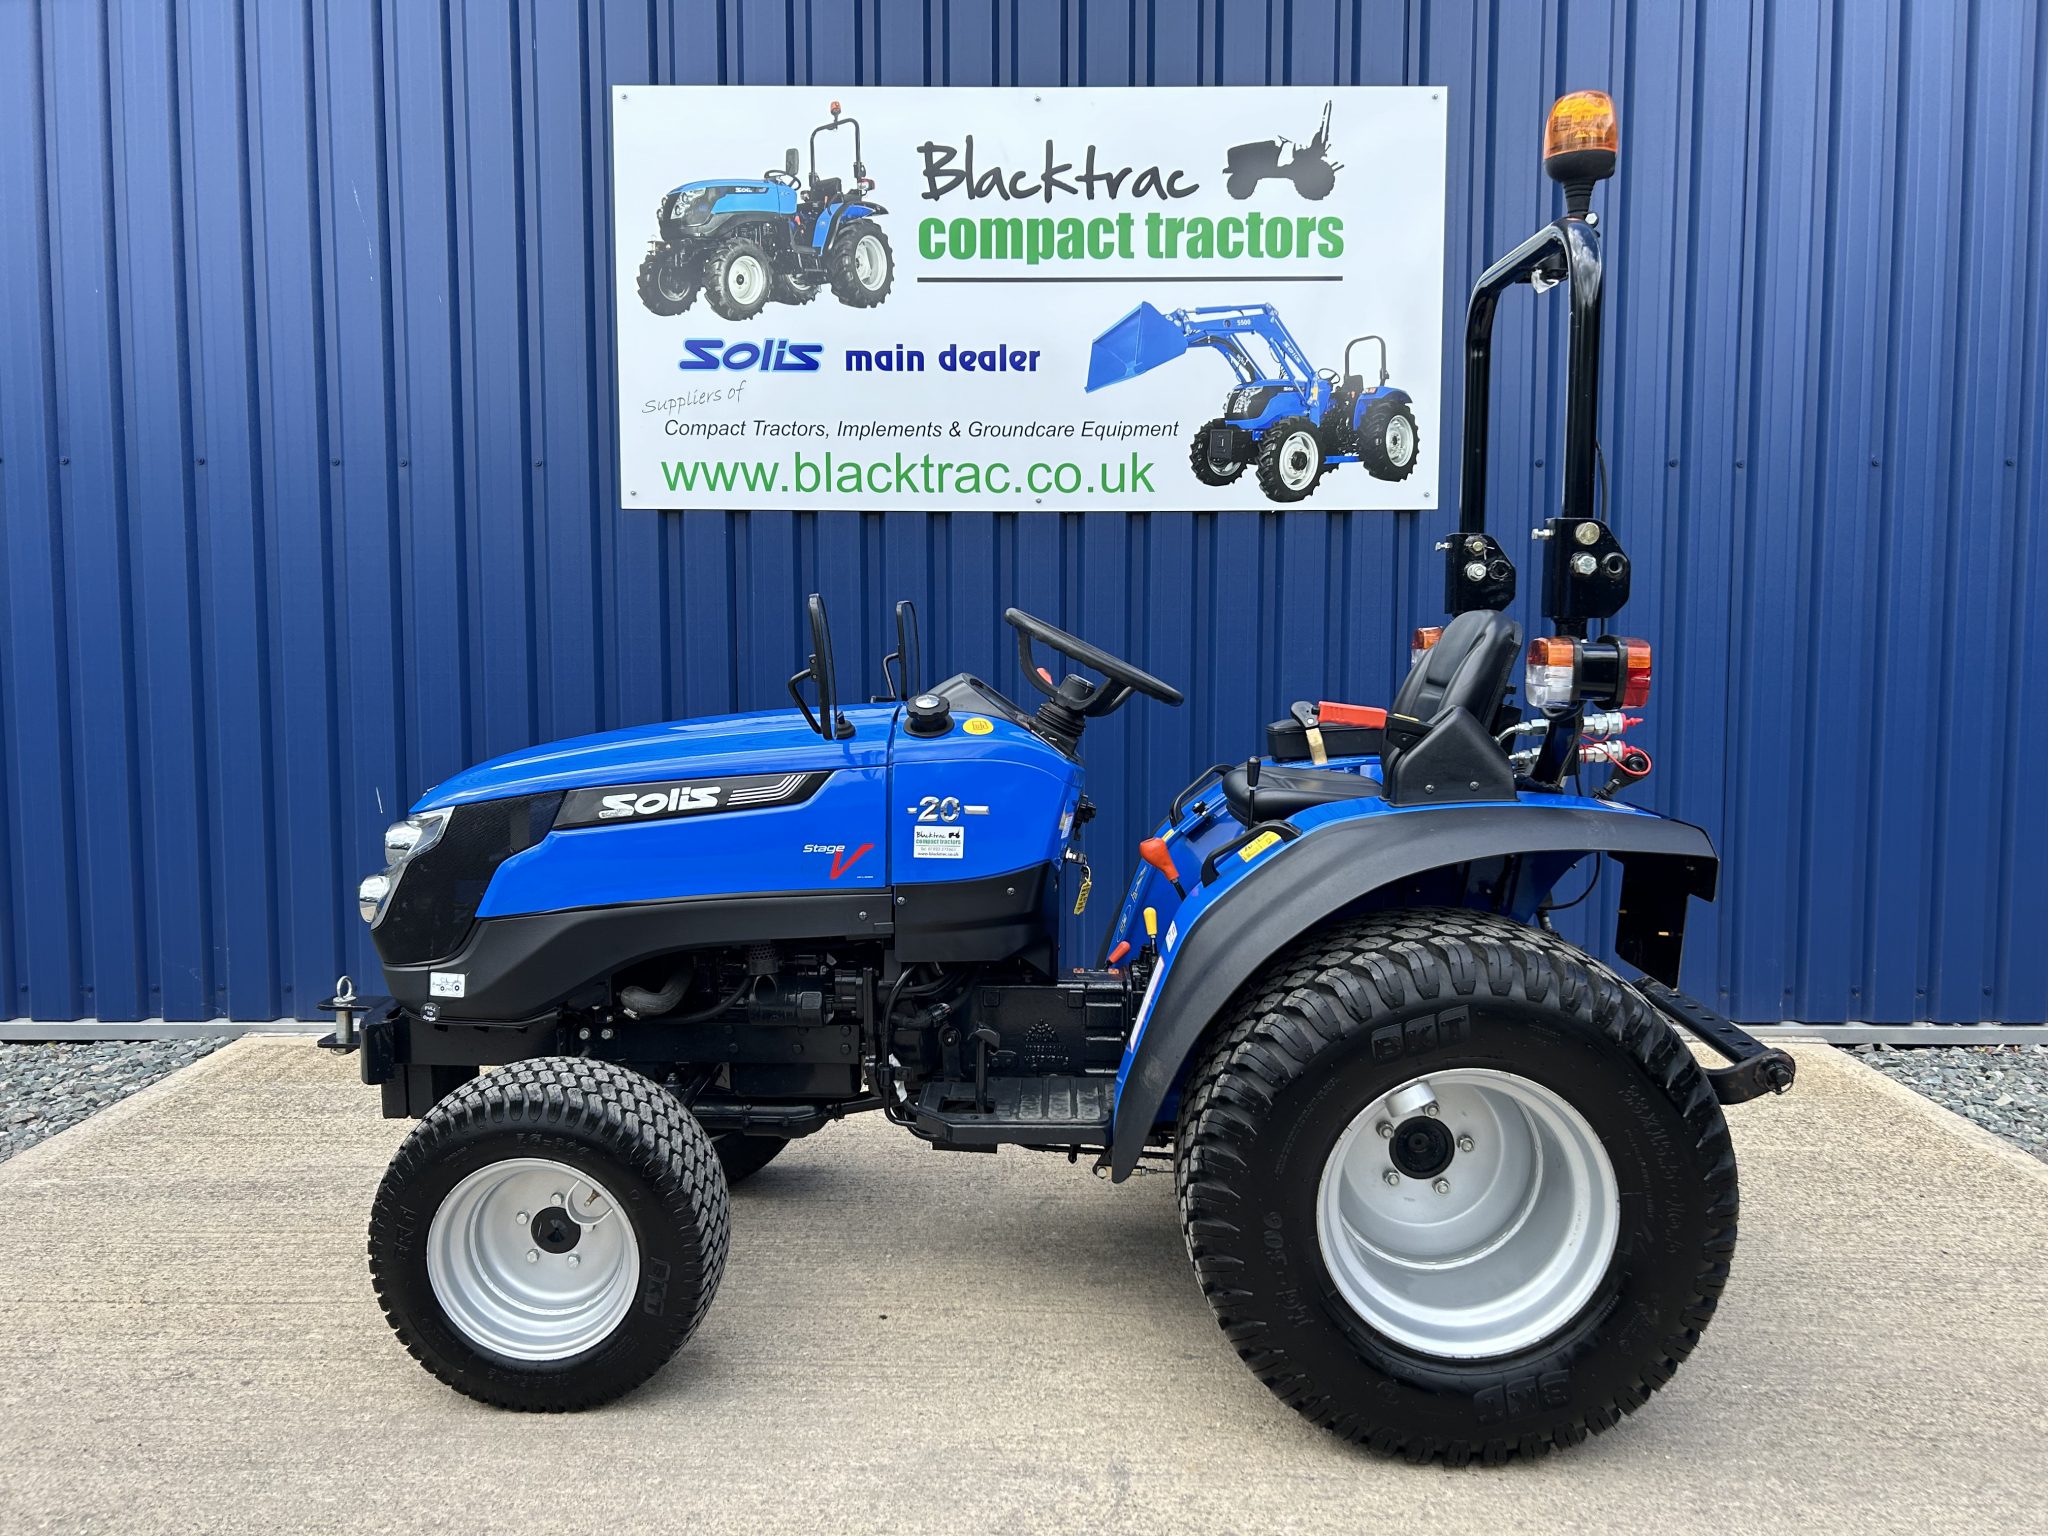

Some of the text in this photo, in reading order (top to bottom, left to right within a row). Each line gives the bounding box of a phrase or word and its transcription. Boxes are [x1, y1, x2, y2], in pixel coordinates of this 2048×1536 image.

[917, 134, 1200, 204] Blacktrac
[918, 211, 1344, 265] compact tractors
[845, 343, 925, 372] main
[938, 343, 1041, 372] dealer
[641, 380, 748, 415] Suppliers of
[664, 419, 1180, 441] Compact Tractors, Implements & Groundcare Equipment
[660, 451, 1156, 494] www.blacktrac.co.uk
[803, 844, 845, 854] Stage
[830, 844, 874, 880] V
[1372, 1007, 1469, 1061] BKT
